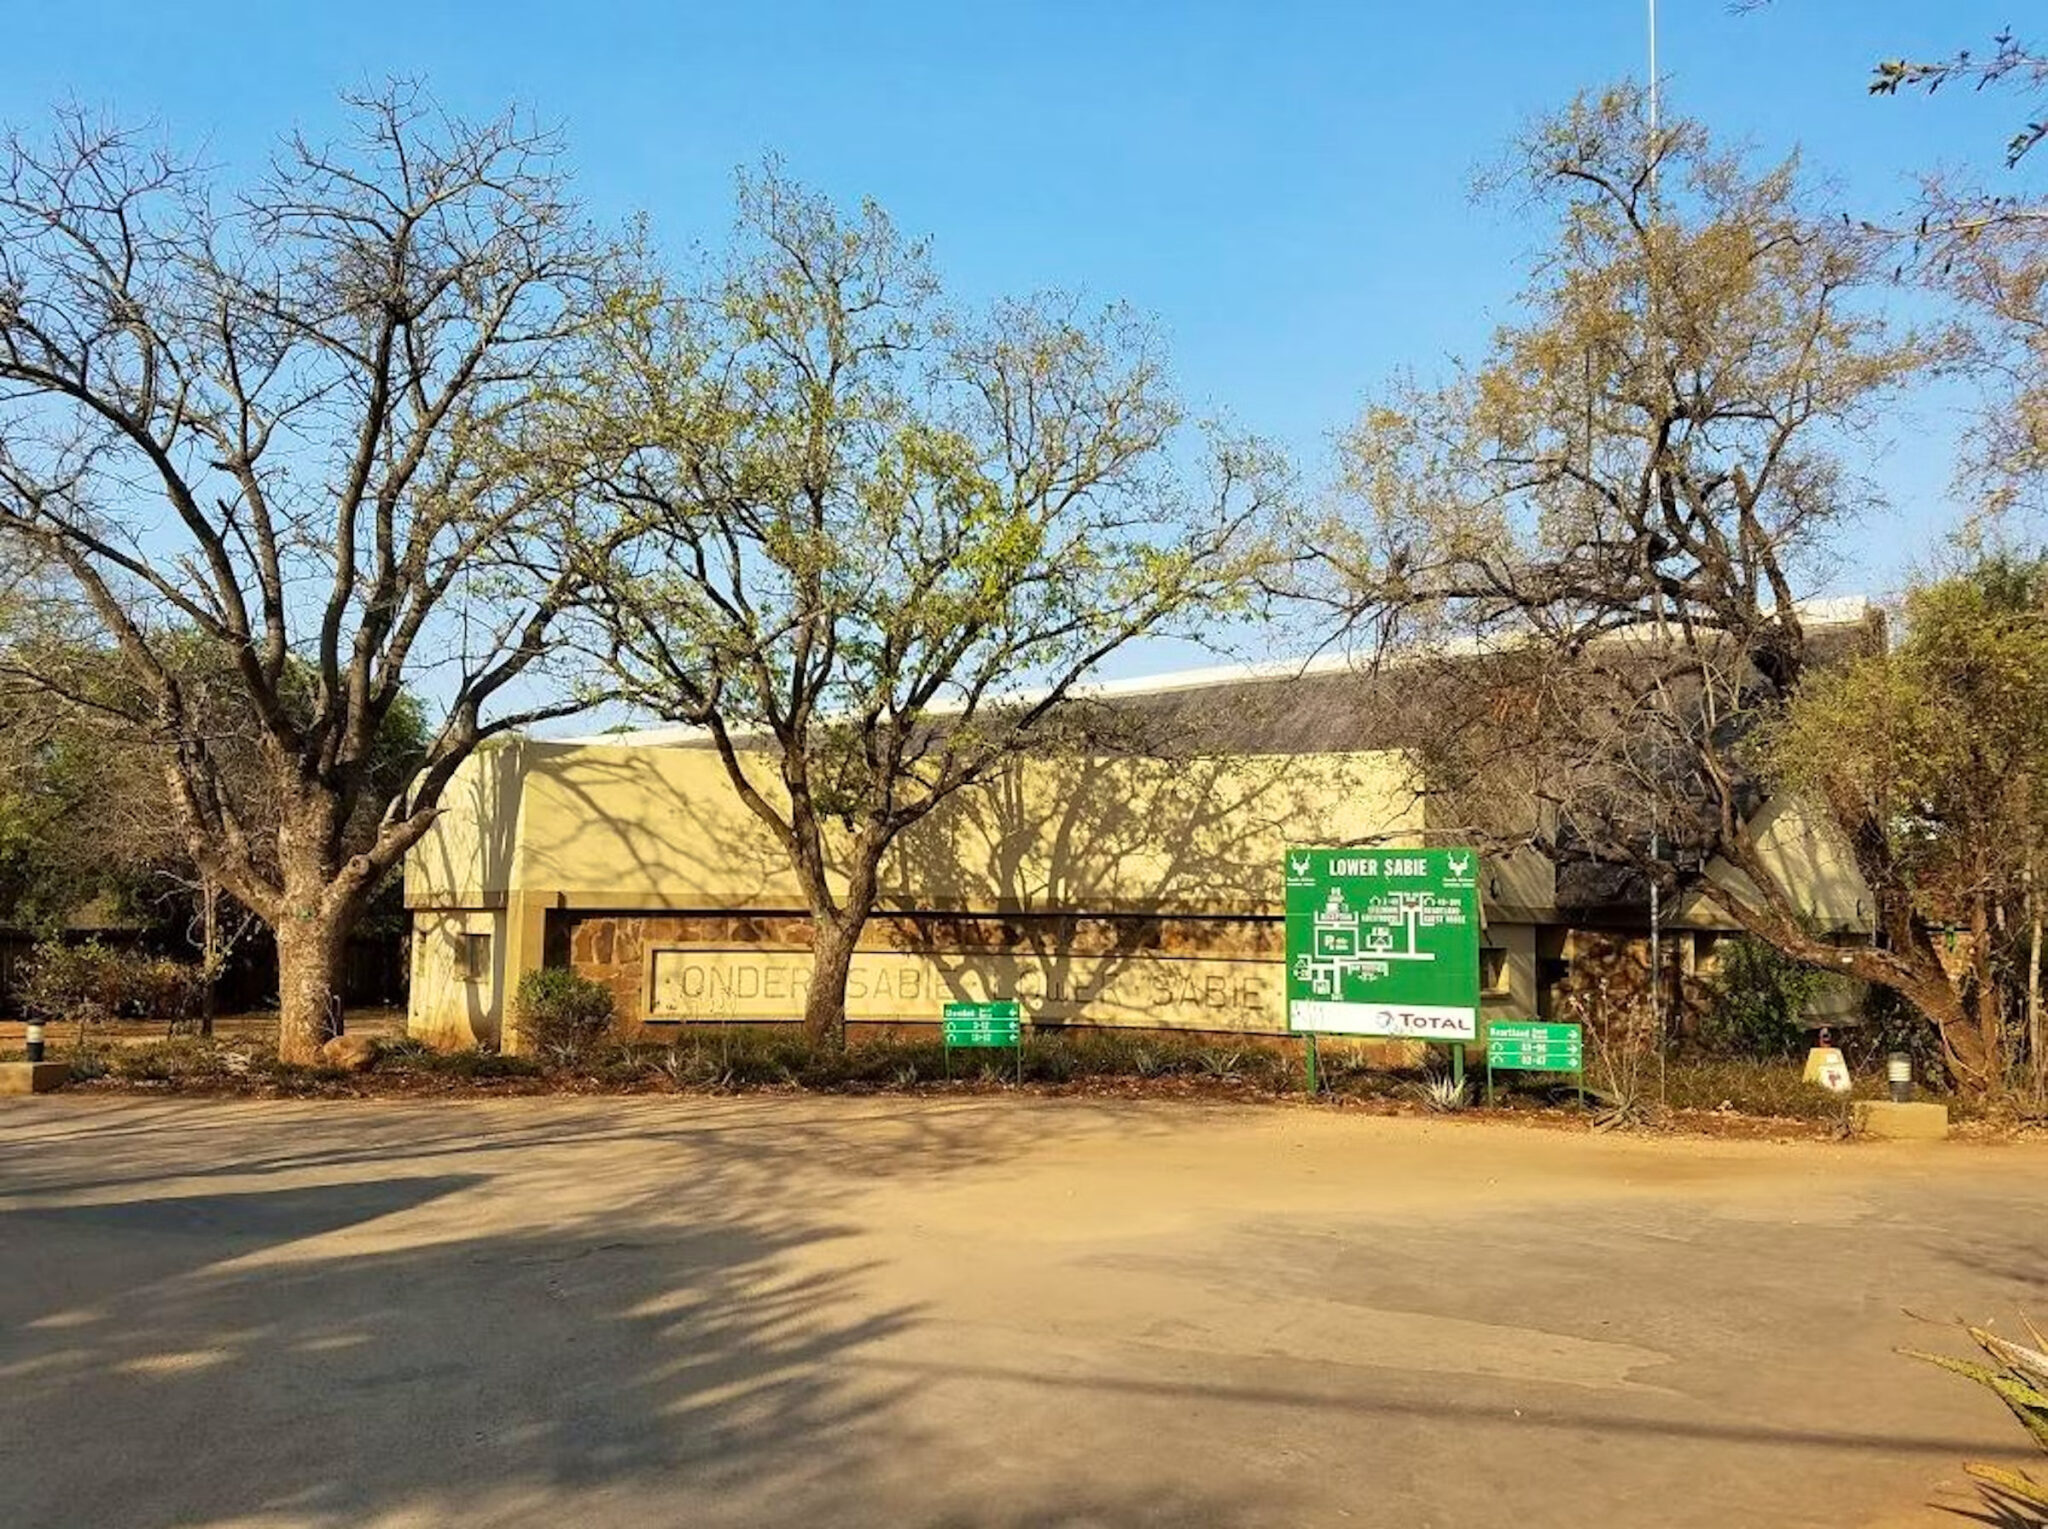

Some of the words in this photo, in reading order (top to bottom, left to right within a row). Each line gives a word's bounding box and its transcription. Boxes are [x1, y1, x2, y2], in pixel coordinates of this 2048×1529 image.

[1328, 858, 1378, 876] LOWER
[1384, 858, 1428, 876] SABIE
[681, 965, 812, 999] ONDER
[848, 967, 954, 1001] SABIE
[1152, 974, 1267, 1012] SABIE
[1399, 1013, 1471, 1031] TOTAL
